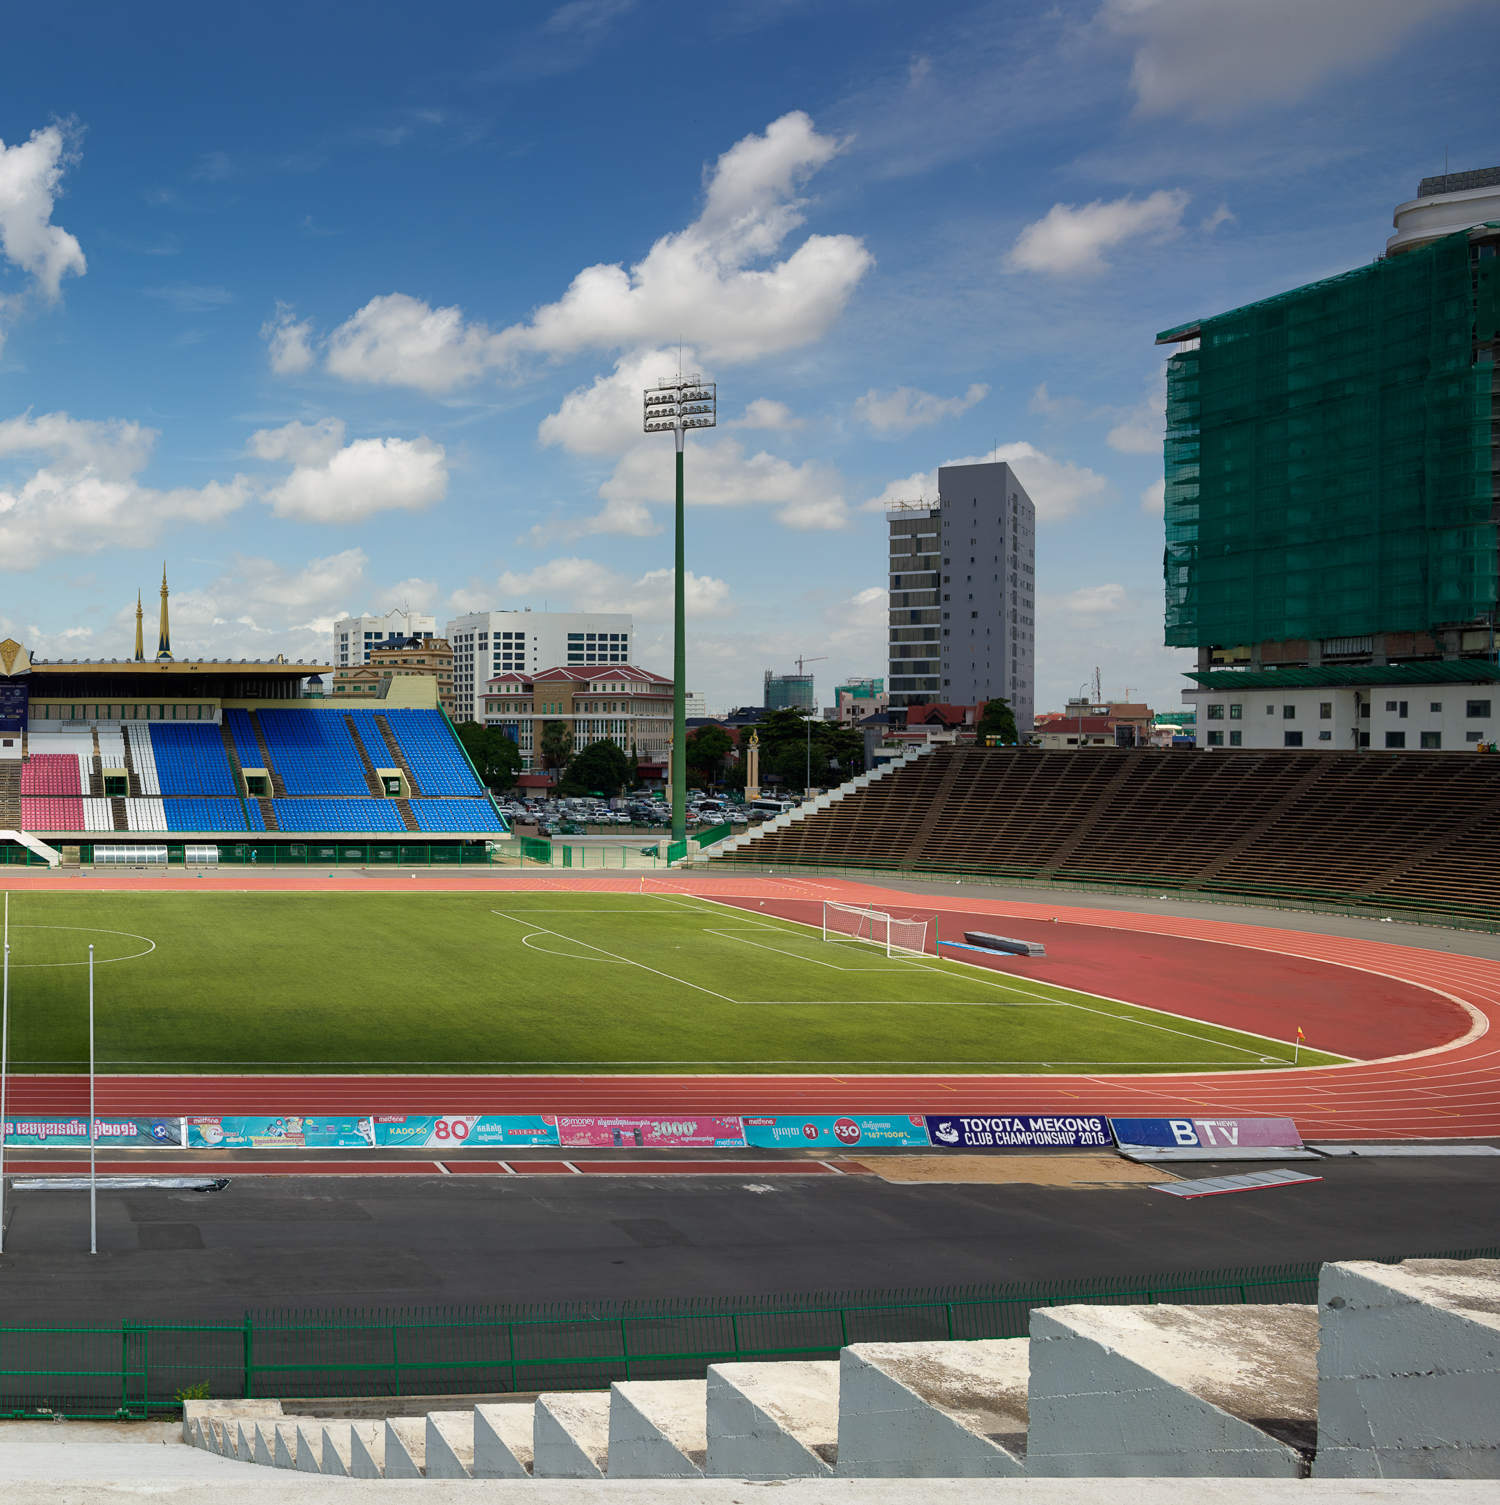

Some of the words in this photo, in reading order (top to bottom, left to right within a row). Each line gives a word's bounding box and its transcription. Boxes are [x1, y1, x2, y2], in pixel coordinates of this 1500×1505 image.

[390, 1127, 414, 1135] KADO
[415, 1127, 428, 1135] 80
[434, 1120, 469, 1140] 80
[805, 1127, 816, 1137] $1
[835, 1125, 859, 1137] $30
[959, 1118, 1025, 1132] TOYOTA
[1029, 1118, 1101, 1132] MEKONG
[964, 1132, 993, 1145] CLUB
[995, 1132, 1076, 1145] CHAMPIONSHIP
[1079, 1132, 1106, 1145] 2016
